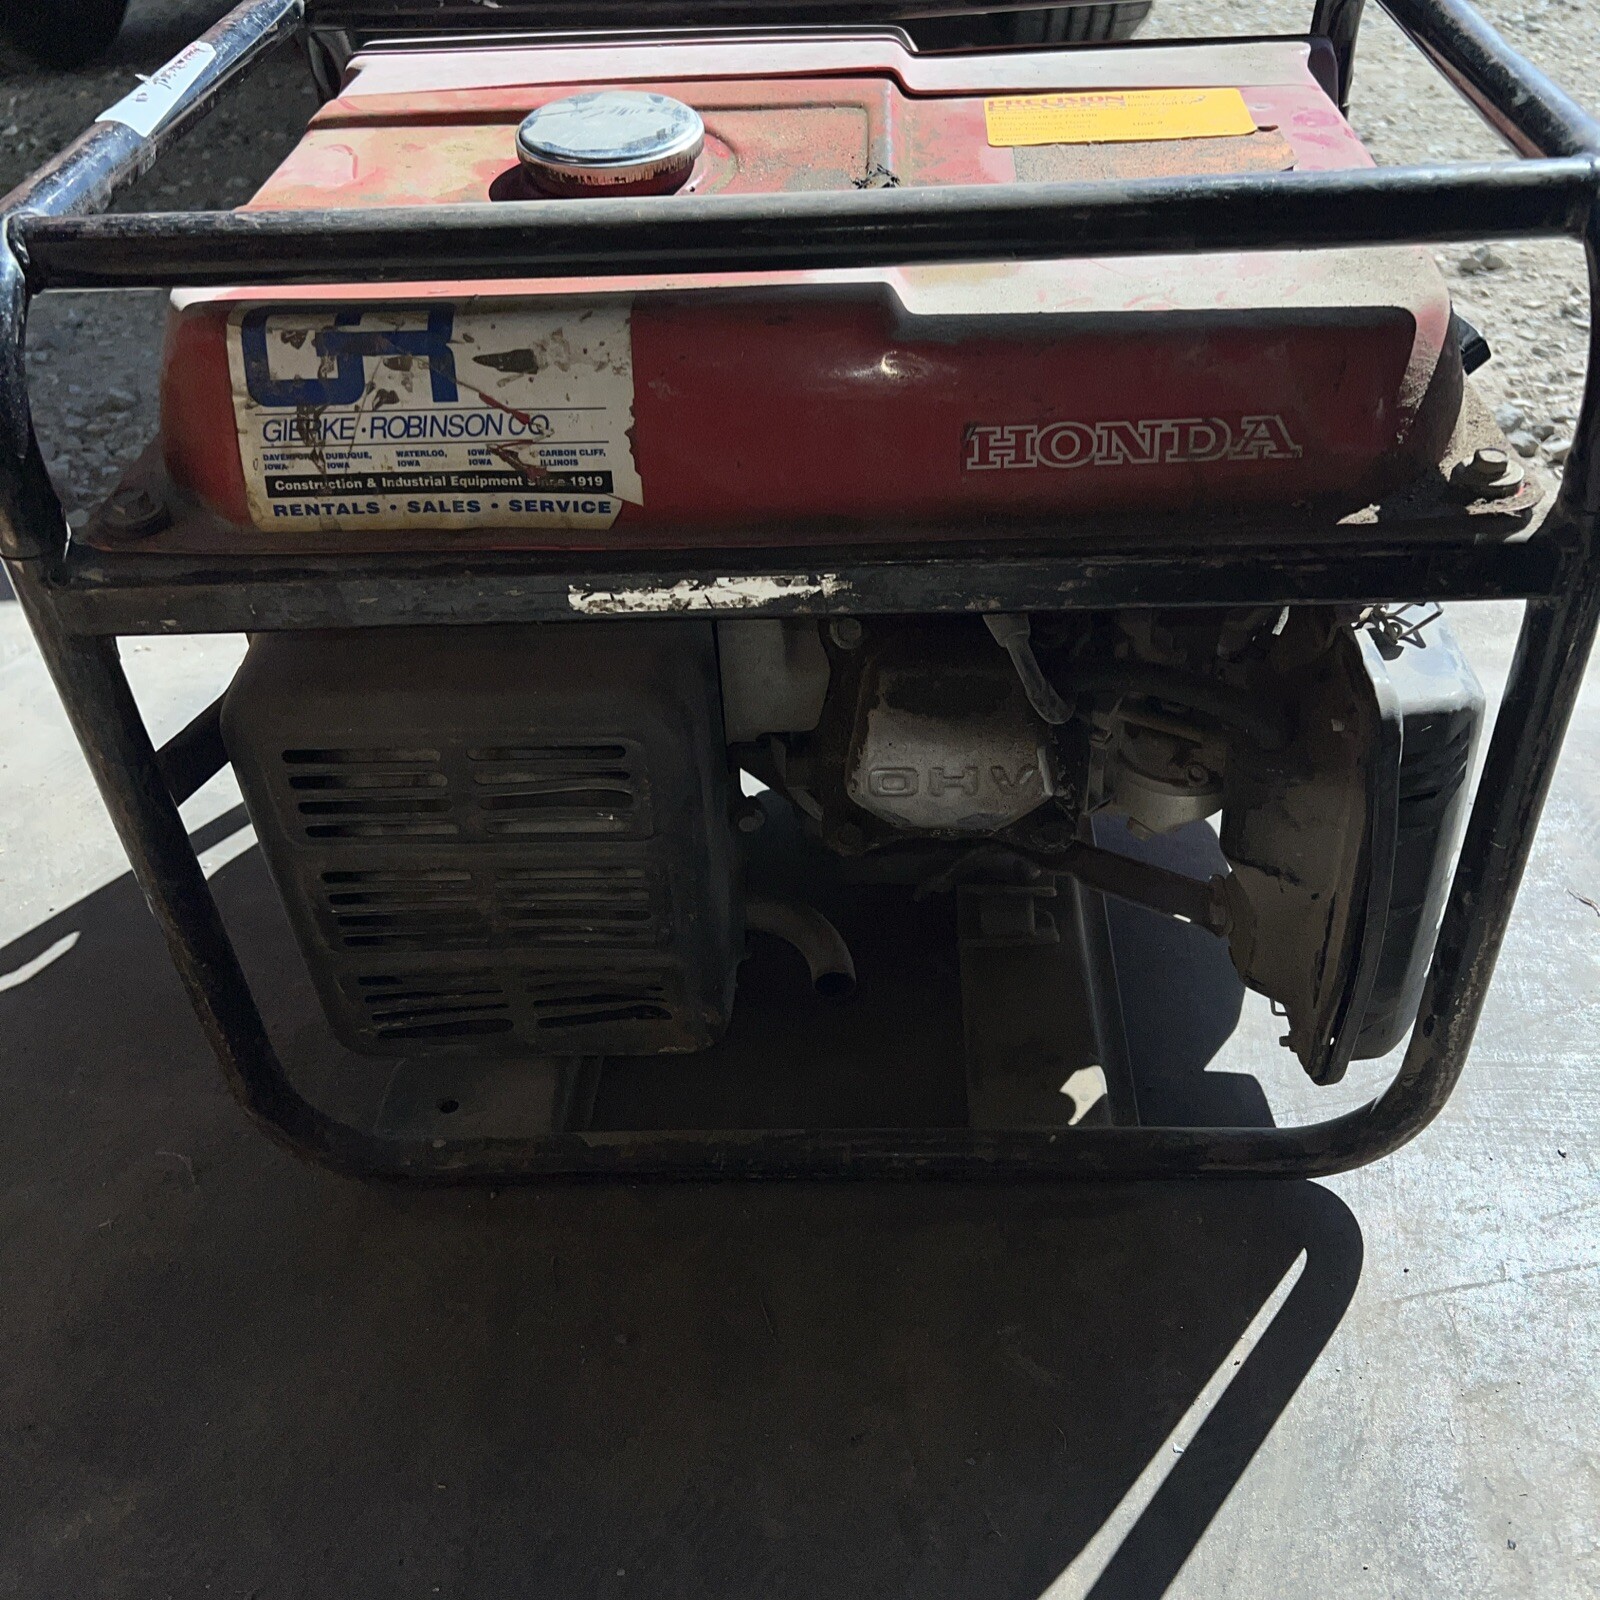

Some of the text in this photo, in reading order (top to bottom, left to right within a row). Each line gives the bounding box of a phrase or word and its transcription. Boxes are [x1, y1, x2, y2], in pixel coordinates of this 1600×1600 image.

[369, 413, 504, 440] ROBINSON
[965, 413, 1304, 470] HONDA
[325, 451, 373, 461] DUBUQUE,
[395, 449, 448, 459] WATERLOO,
[538, 448, 606, 458] CARBON CLIFF,
[264, 463, 288, 471] IOWA
[327, 461, 350, 470] IOWA
[397, 459, 421, 468] IOWA
[468, 458, 493, 467] IOWA
[540, 458, 579, 467] ILLINOIS
[275, 478, 363, 492] Construction
[366, 478, 377, 489] &
[381, 474, 447, 488] Industrial
[450, 474, 523, 492] Equipment
[570, 476, 604, 487] 1919
[272, 498, 612, 517] RENTALS SALES SERVICE
[868, 763, 1039, 798] OHV
